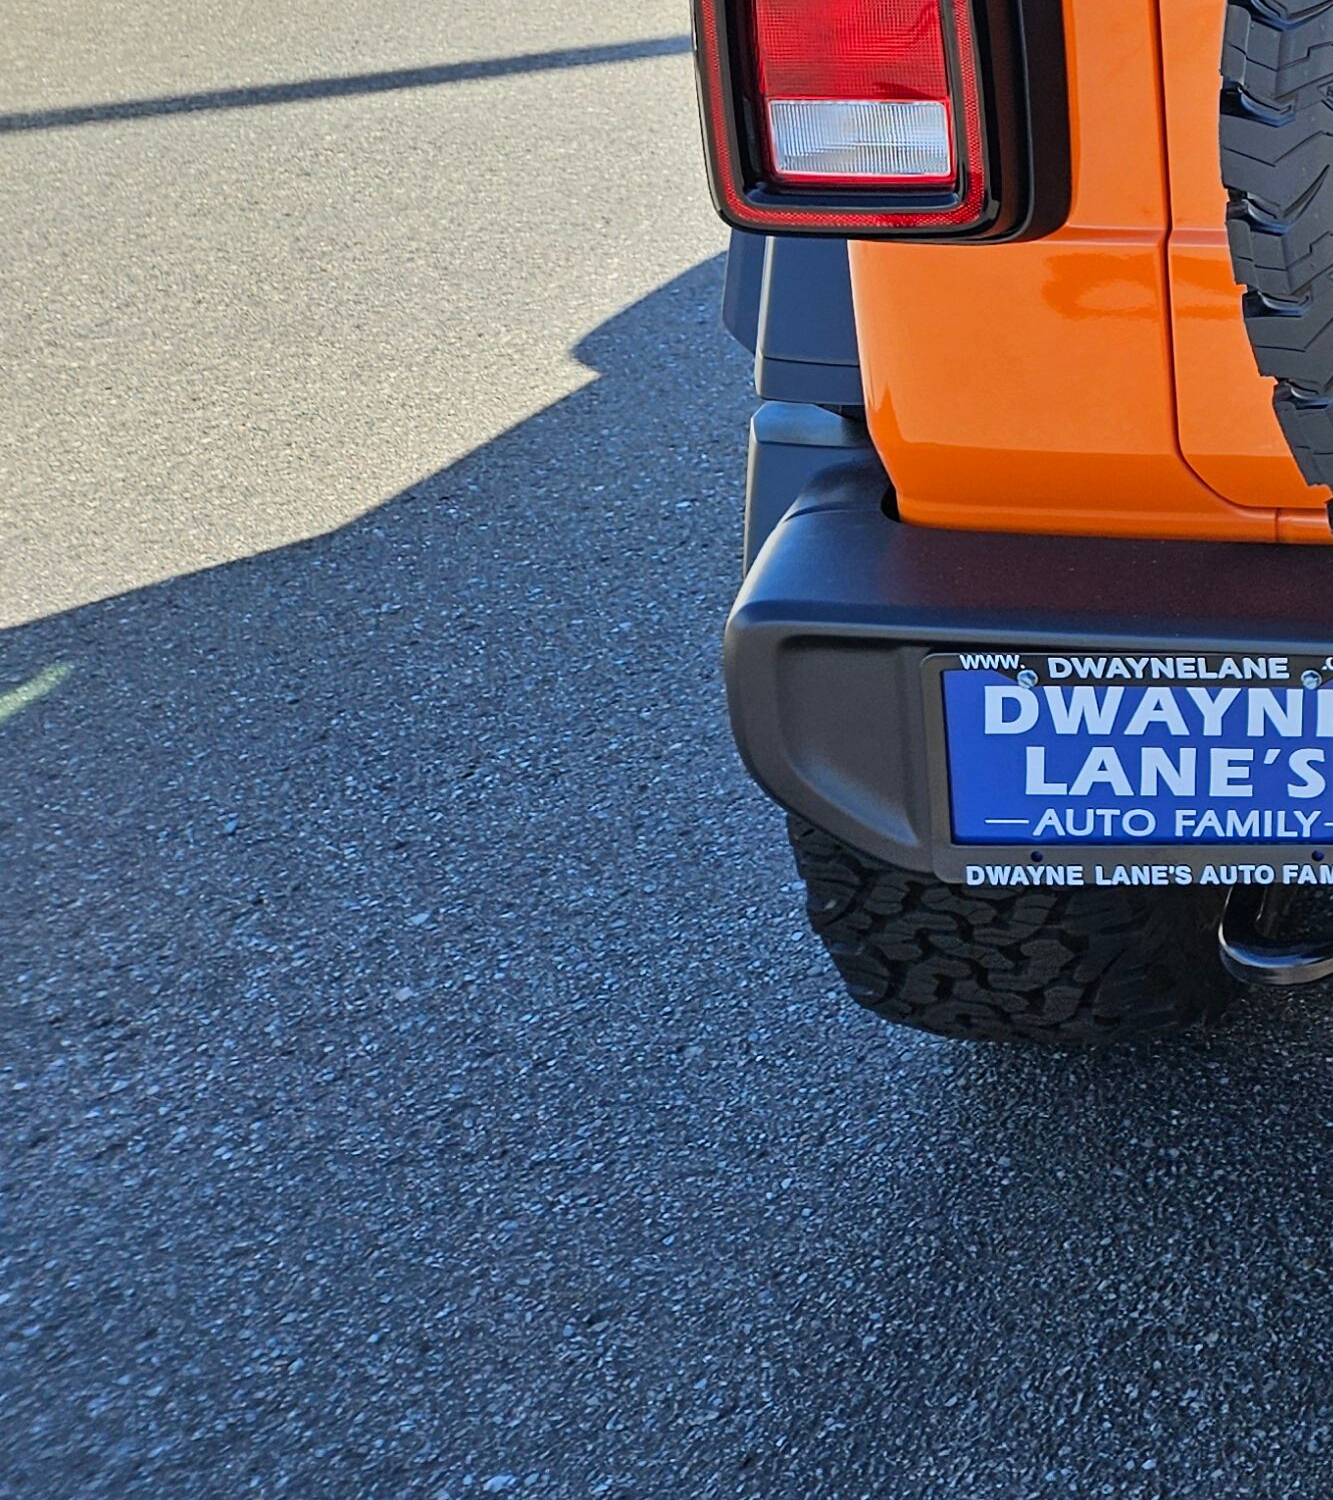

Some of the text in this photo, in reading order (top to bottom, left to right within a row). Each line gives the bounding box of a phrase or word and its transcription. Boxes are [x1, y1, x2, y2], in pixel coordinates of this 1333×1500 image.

[1047, 657, 1291, 680] DWAYNELANE
[1025, 746, 1327, 799] LANE'S
[1032, 808, 1322, 839] AUTO FAMILY
[965, 865, 1084, 887] DWAYNE
[1095, 865, 1193, 887] LANE'S
[1200, 865, 1275, 887] AUTO
